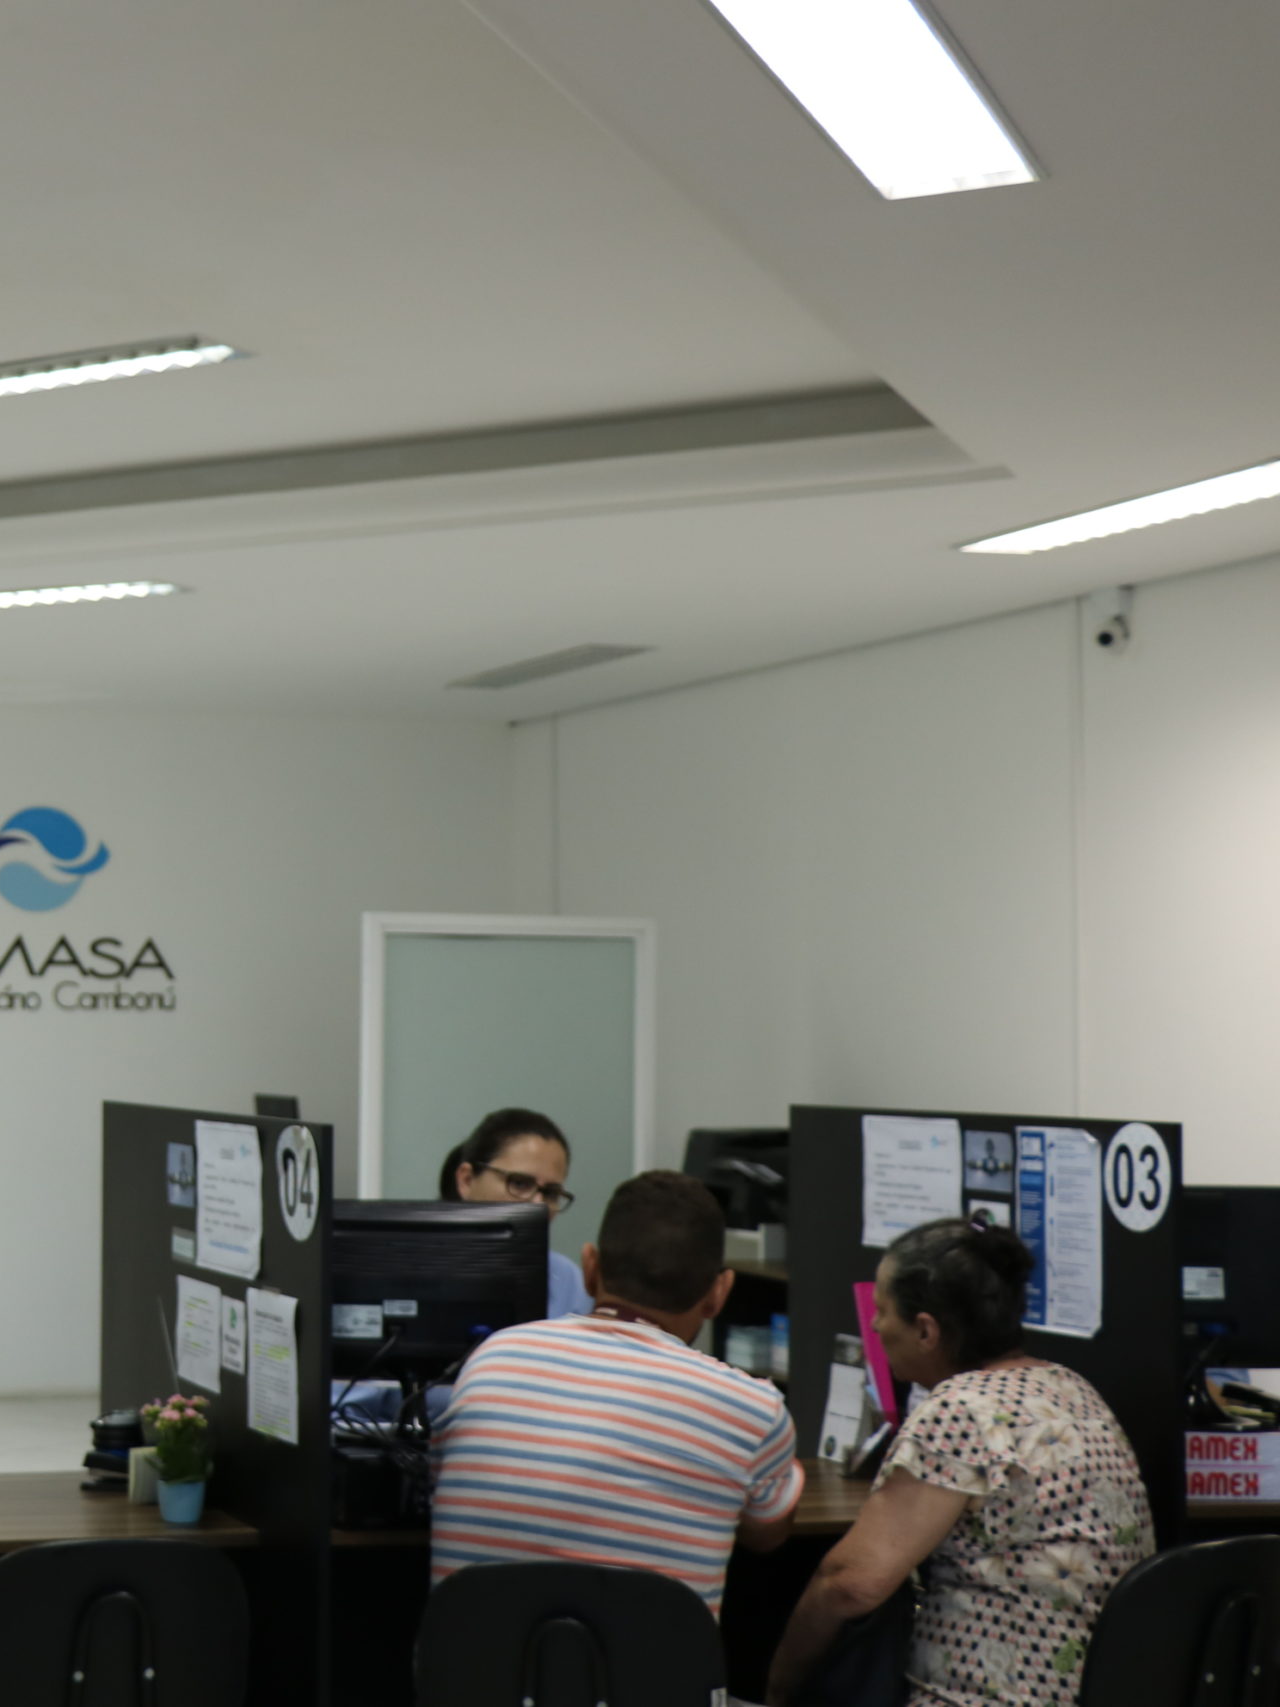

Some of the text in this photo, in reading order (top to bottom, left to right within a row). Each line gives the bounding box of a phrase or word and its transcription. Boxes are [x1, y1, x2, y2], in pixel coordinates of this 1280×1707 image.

[280, 1147, 315, 1220] 04
[1112, 1143, 1163, 1211] 03
[1188, 1435, 1258, 1461] AMEX
[1189, 1471, 1259, 1497] AMEX
